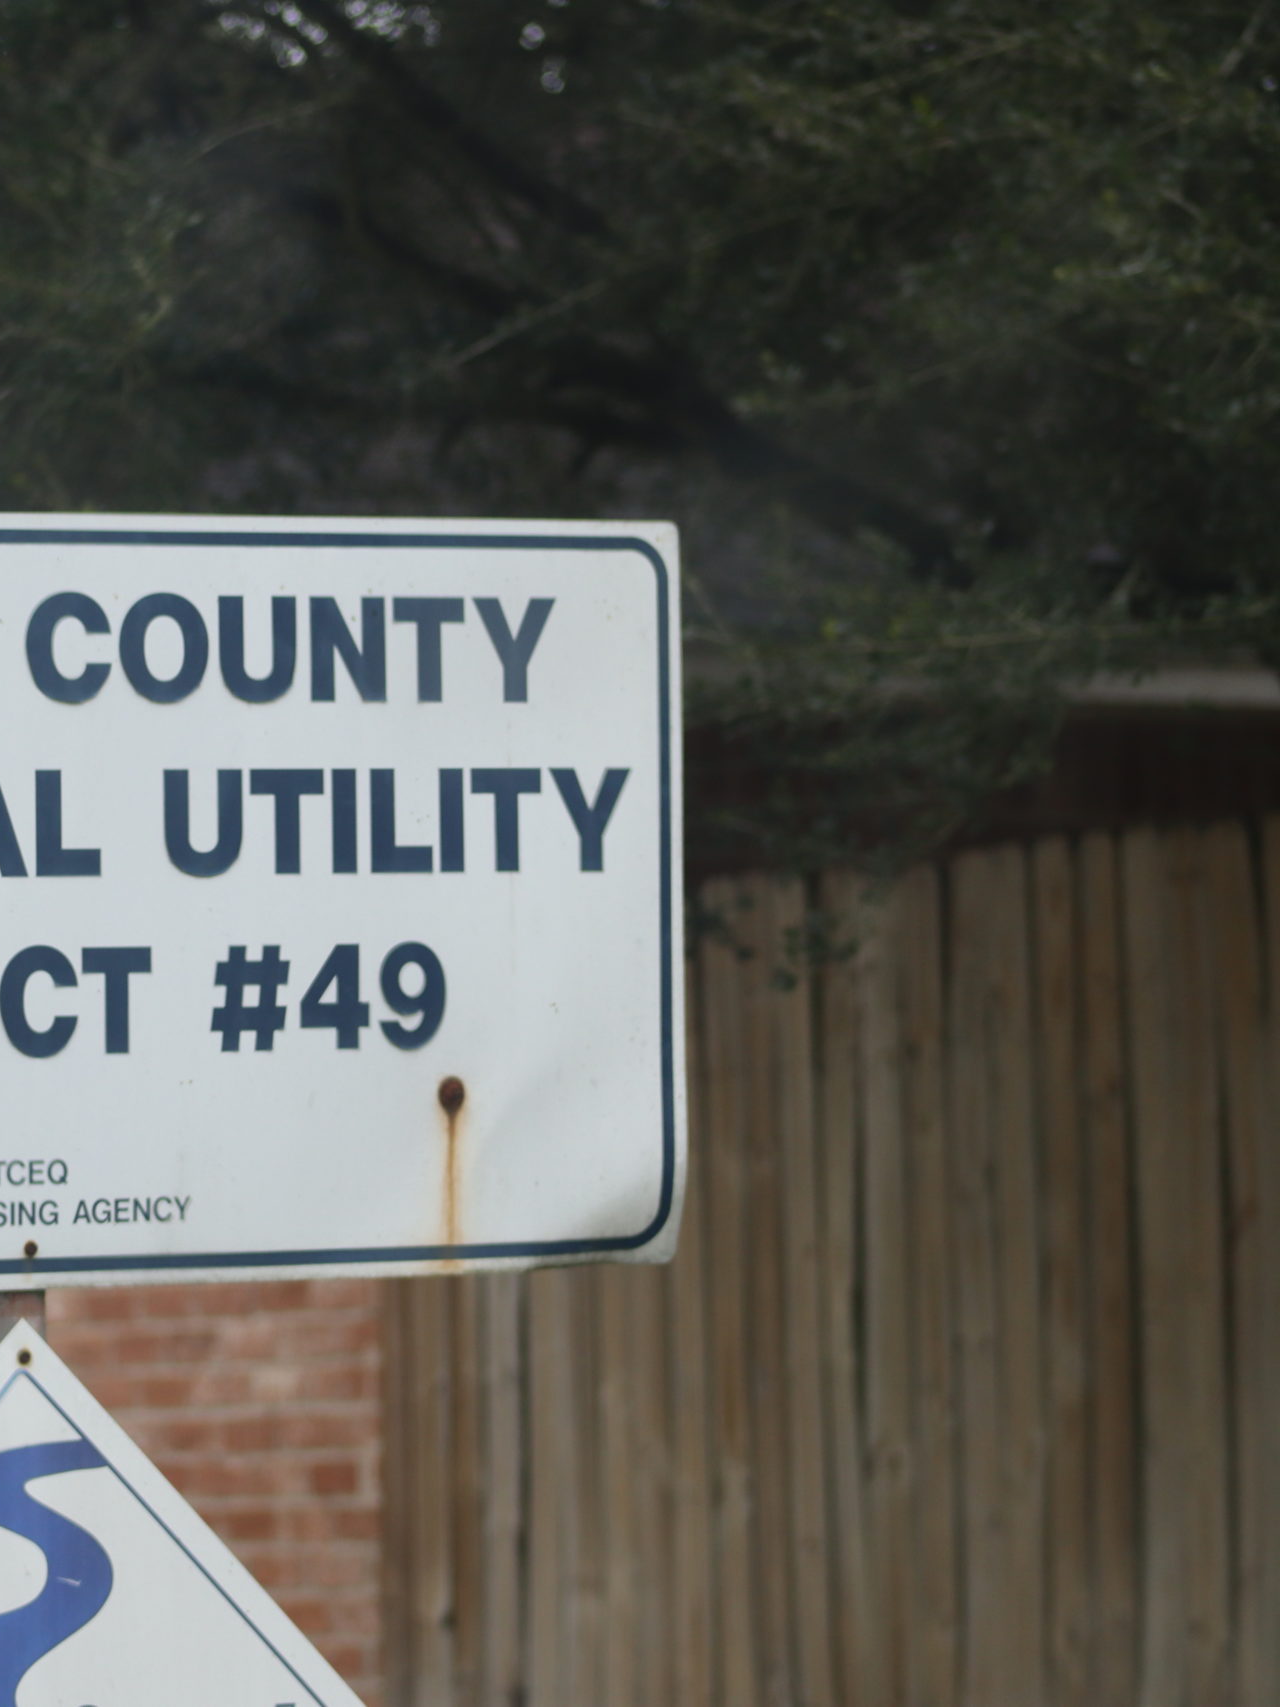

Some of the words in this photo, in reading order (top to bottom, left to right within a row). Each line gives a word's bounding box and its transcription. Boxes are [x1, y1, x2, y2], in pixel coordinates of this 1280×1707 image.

[24, 591, 556, 706] COUNTY
[162, 767, 631, 879] UTILITY
[210, 941, 447, 1053] #49
[73, 1196, 191, 1225] AGENCY
